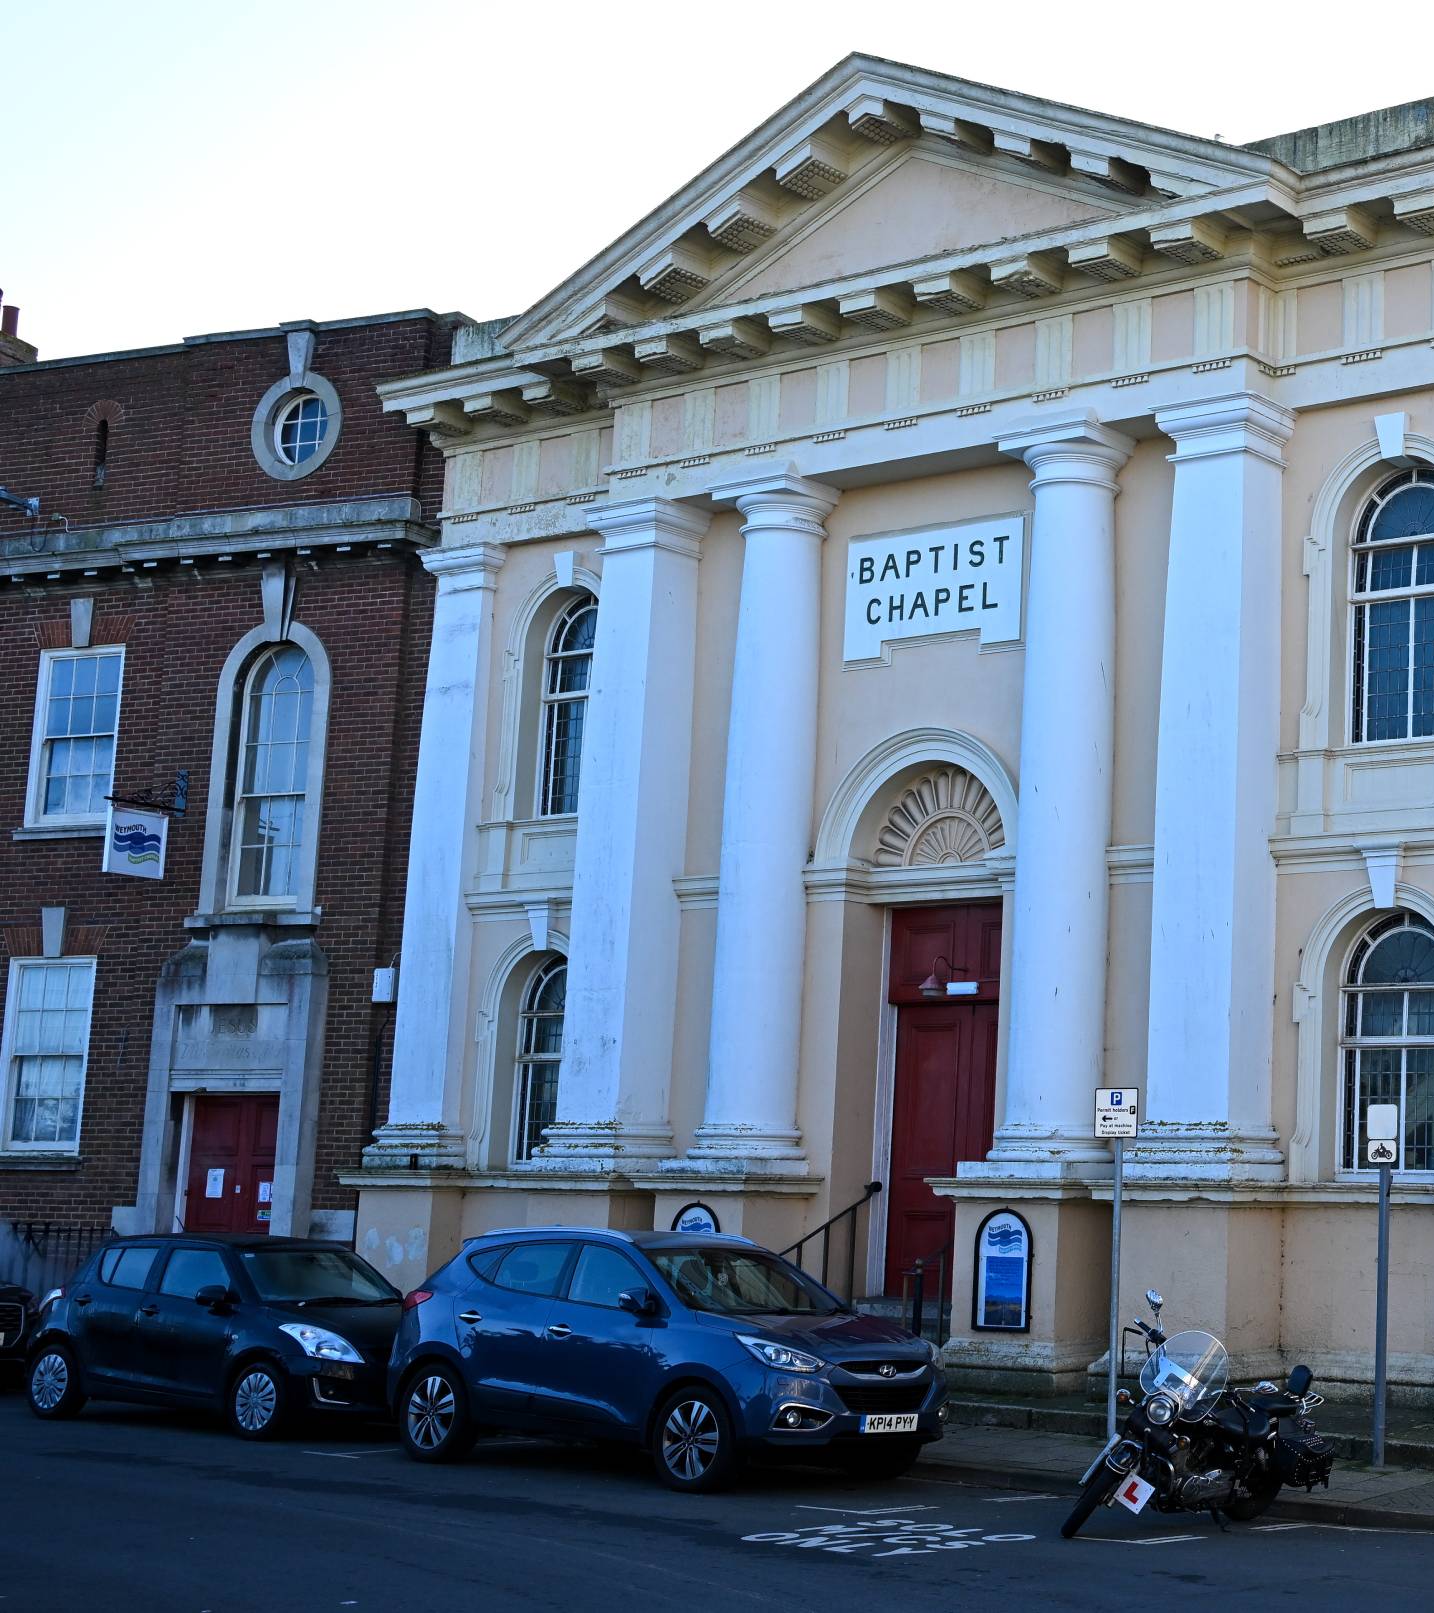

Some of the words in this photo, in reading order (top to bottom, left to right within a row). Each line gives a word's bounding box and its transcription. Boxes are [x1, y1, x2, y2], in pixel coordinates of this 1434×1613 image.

[859, 535, 1010, 584] BAPTIST
[866, 582, 998, 625] CHAPEL
[115, 824, 147, 834] WEYMOUTH
[869, 1416, 892, 1430] KP14
[895, 1416, 914, 1429] PYY
[1123, 1481, 1139, 1504] L
[856, 1519, 1037, 1543] SOLO
[740, 1532, 939, 1557] ONLY
